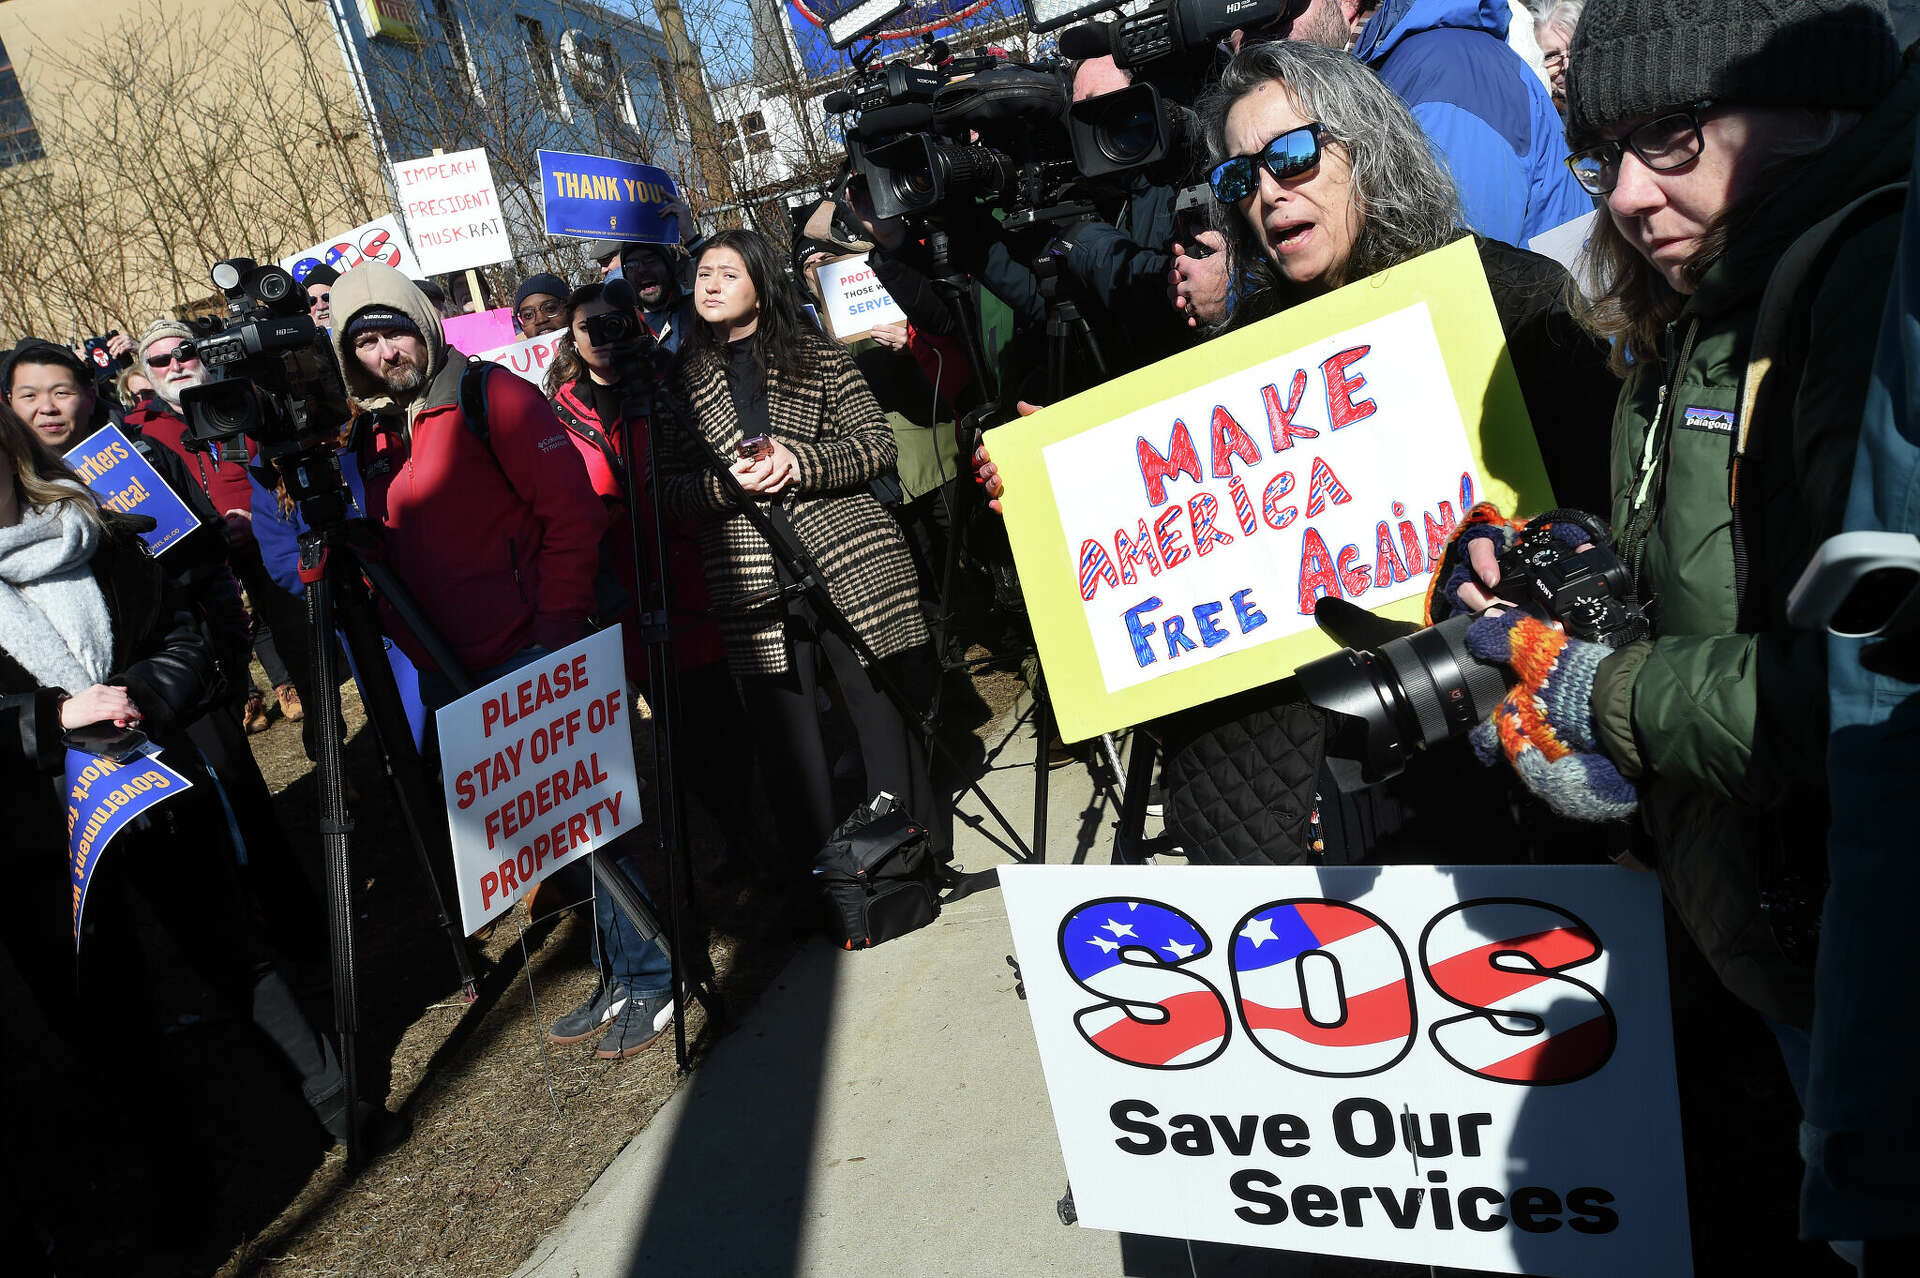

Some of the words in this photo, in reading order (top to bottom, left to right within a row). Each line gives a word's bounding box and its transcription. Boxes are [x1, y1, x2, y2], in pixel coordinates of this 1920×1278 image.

[1226, 2, 1241, 14] HD
[403, 160, 477, 186] IMPEACH
[552, 171, 621, 202] THANK
[408, 188, 491, 219] PRESIDENT
[844, 286, 874, 300] THOSE
[848, 296, 896, 316] SERVE
[1136, 345, 1377, 507] MAKE
[1686, 418, 1733, 431] patagoni
[73, 441, 129, 487] orkers
[101, 475, 150, 514] rica!
[1536, 579, 1553, 599] SONY
[1121, 588, 1268, 668] FREE
[482, 654, 588, 738] PLEASE
[455, 738, 524, 810] STAY
[530, 709, 581, 765] OFF
[588, 689, 621, 734] OF
[74, 770, 171, 880] Government
[485, 753, 608, 850] FEDERAL
[480, 791, 623, 911] PROPERTY
[1057, 897, 1618, 1086] SOS
[1109, 1098, 1311, 1156] Save
[1332, 1097, 1493, 1158] Our
[1229, 1170, 1620, 1235] Services
